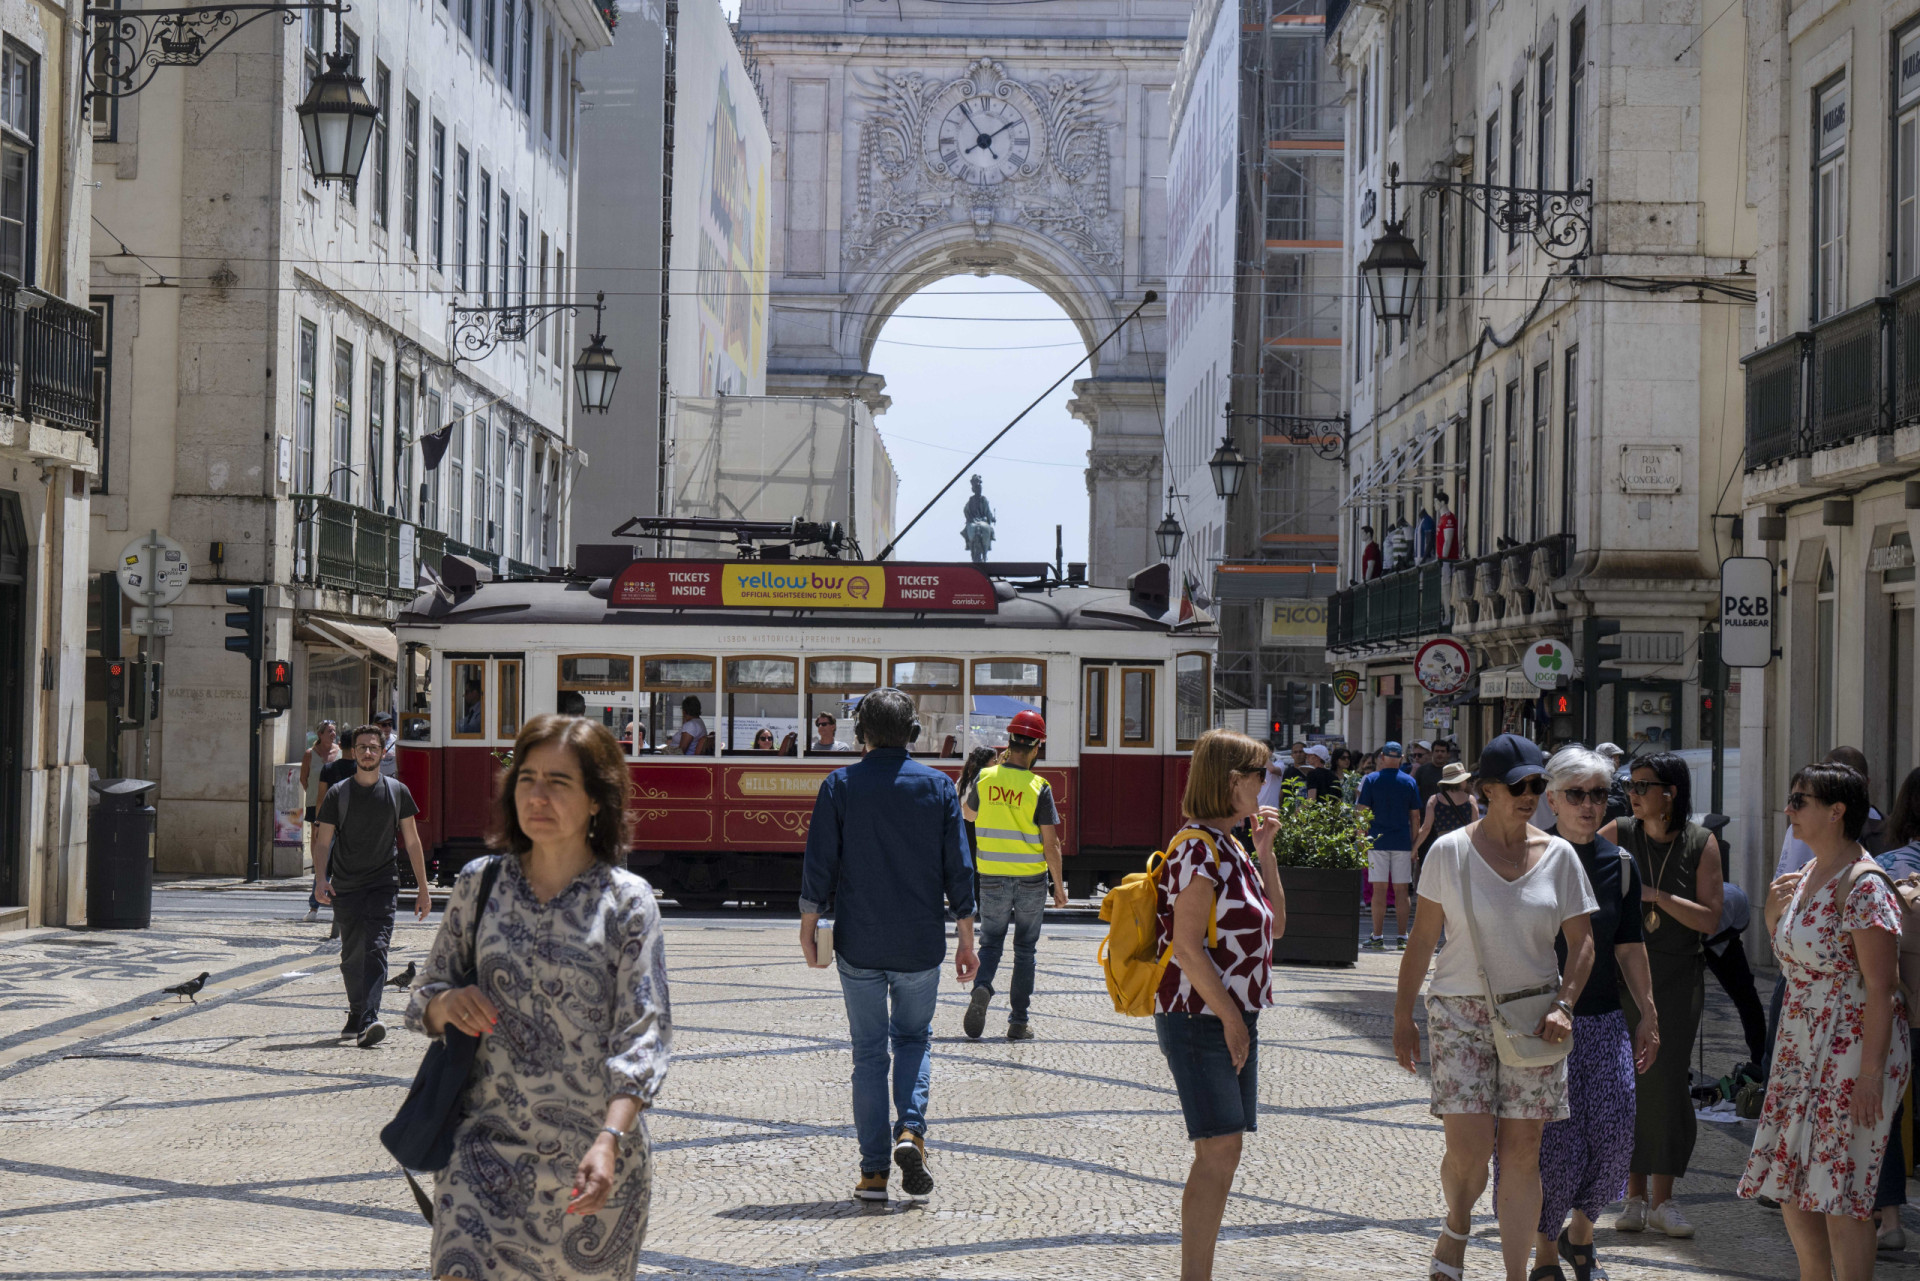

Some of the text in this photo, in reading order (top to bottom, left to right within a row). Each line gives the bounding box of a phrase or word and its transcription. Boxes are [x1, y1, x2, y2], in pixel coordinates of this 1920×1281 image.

[1642, 456, 1661, 464] RUA
[1645, 466, 1657, 474] DA
[668, 573, 710, 583] TICKETS
[812, 572, 844, 590] bus
[897, 575, 940, 586] TICKETS
[672, 586, 706, 596] INSIDE
[901, 589, 935, 599] INSIDE
[1725, 596, 1769, 617] P&B
[1725, 619, 1769, 627] PULL&BEAR
[752, 635, 799, 643] HISTORICAL
[805, 636, 841, 644] PREMIUM
[847, 636, 882, 645] TRAMCAR
[1535, 672, 1560, 682] JOGO
[745, 777, 777, 790] HILLS
[988, 785, 1023, 806] DVM
